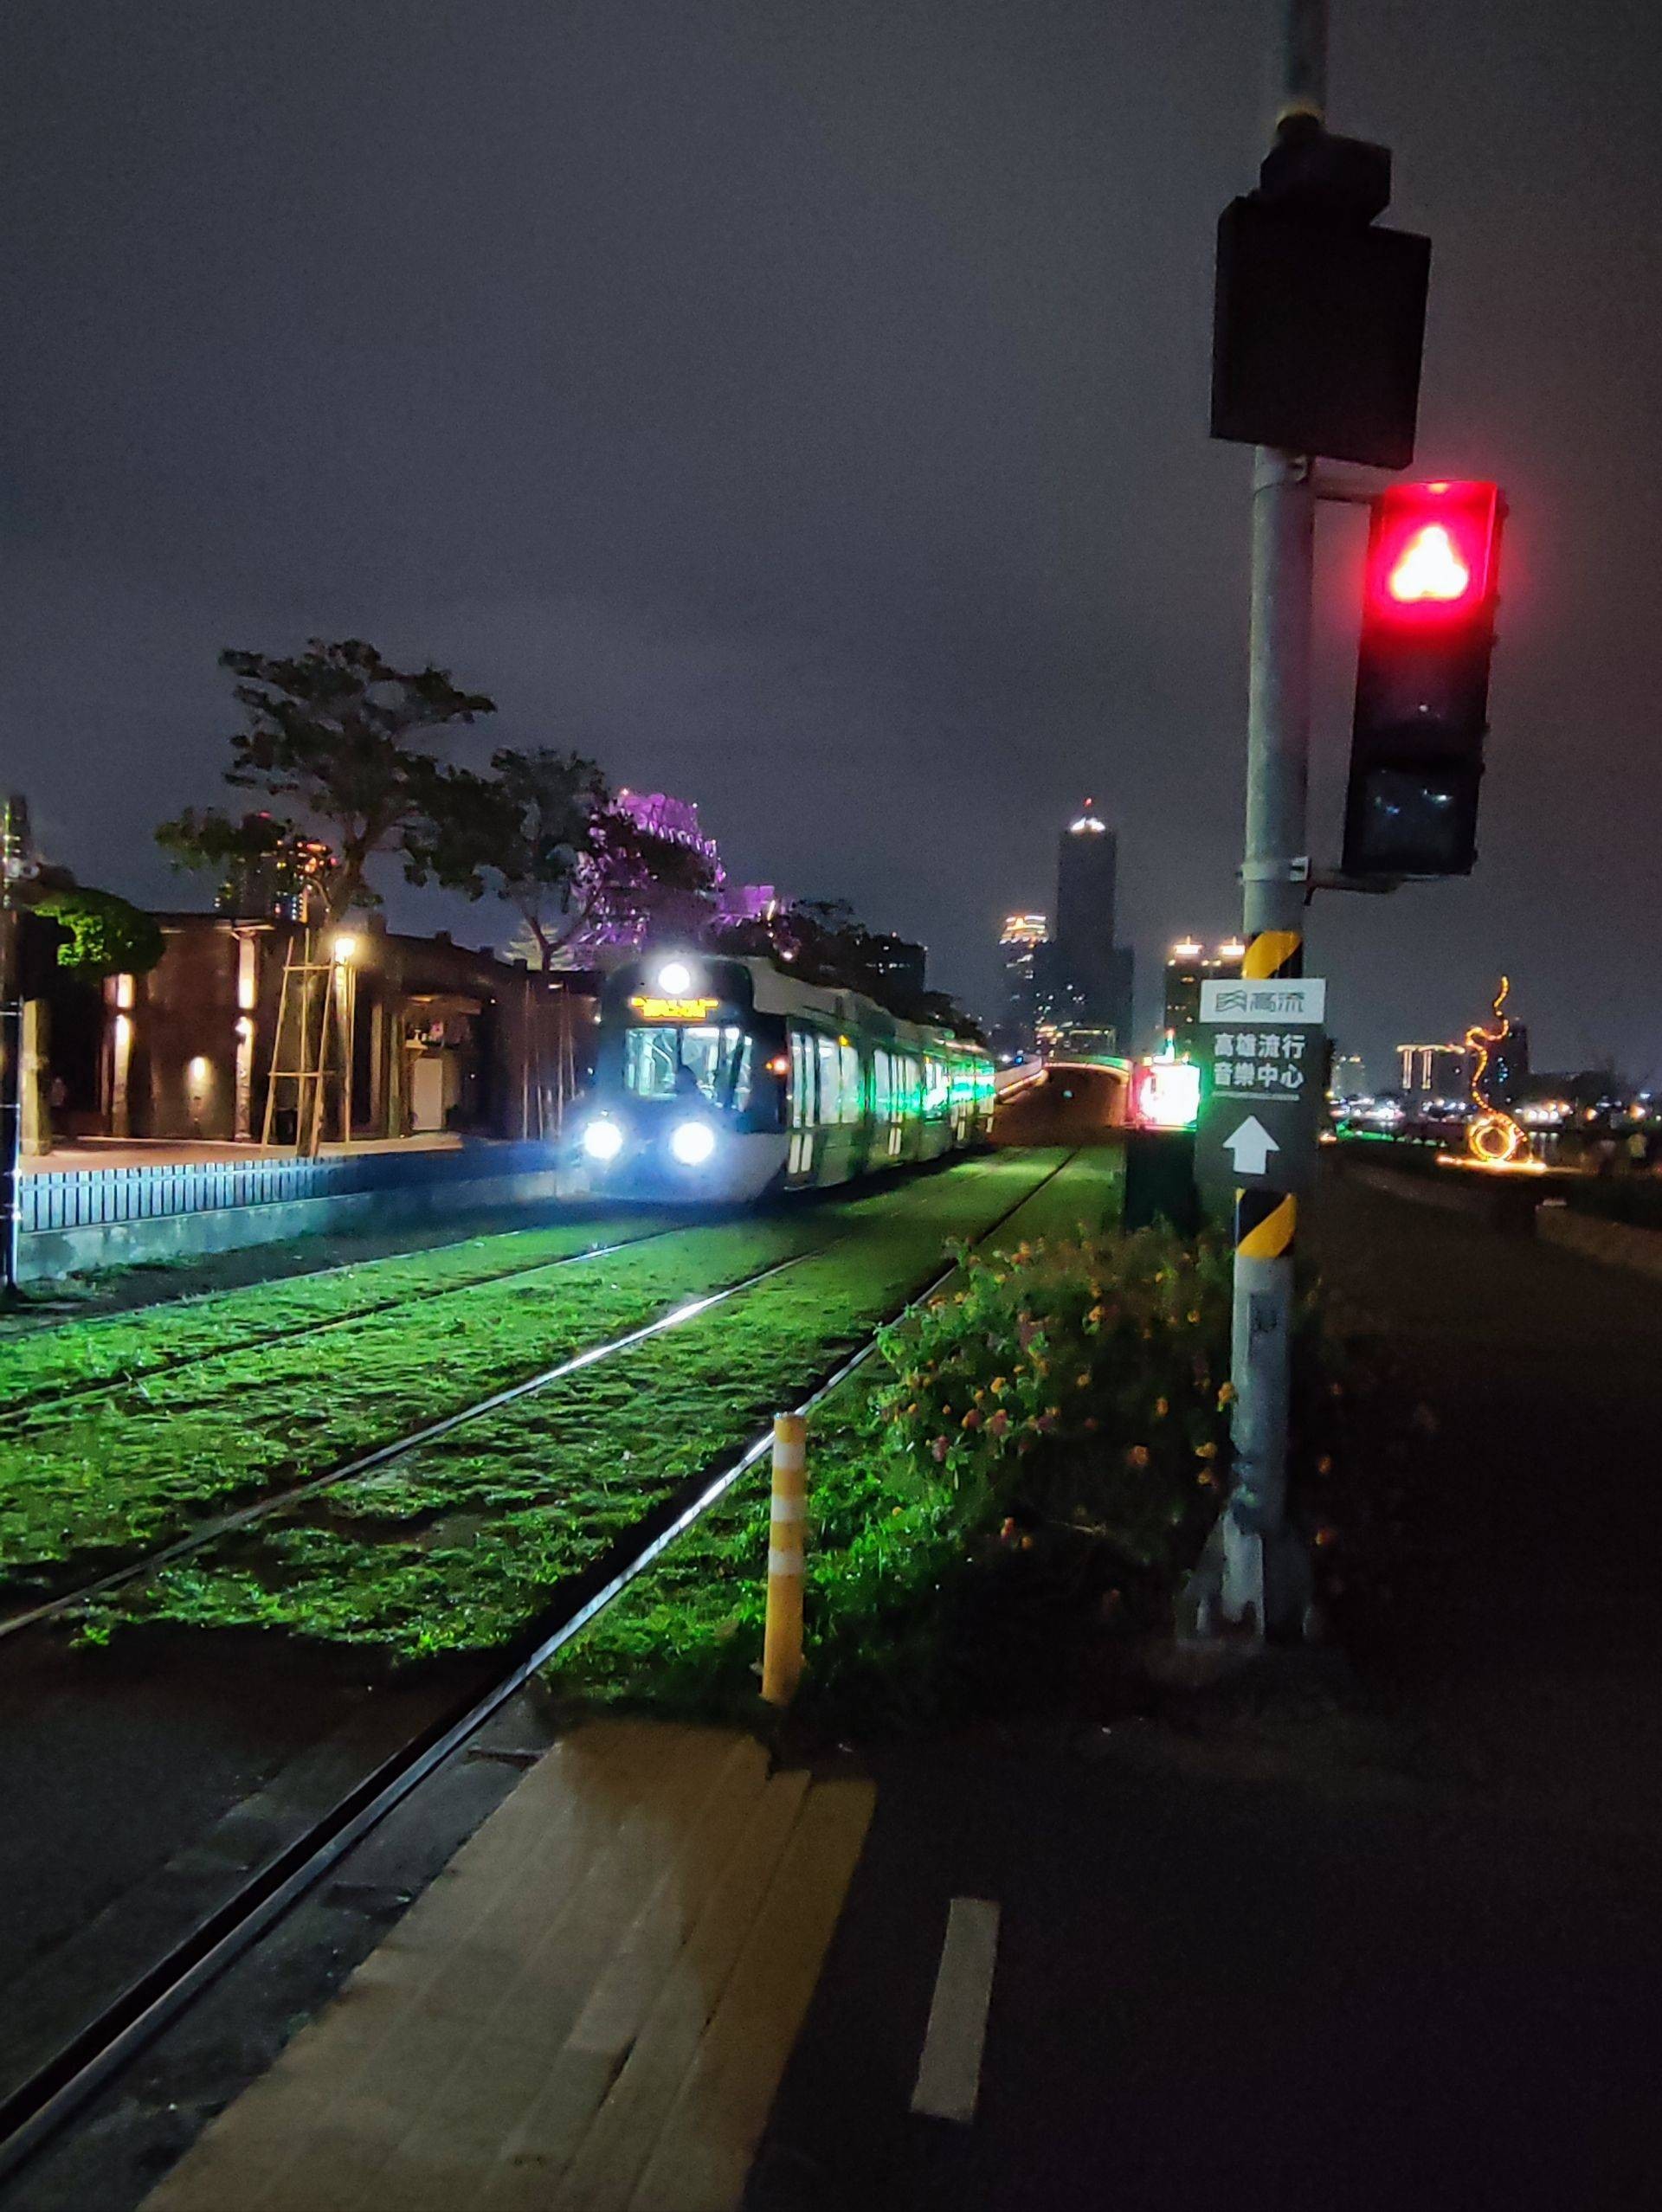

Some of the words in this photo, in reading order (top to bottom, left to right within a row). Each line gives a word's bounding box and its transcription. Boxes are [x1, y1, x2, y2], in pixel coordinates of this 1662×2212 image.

[1214, 1032, 1305, 1059] 高雄流行
[1214, 1062, 1304, 1090] 音樂中心
